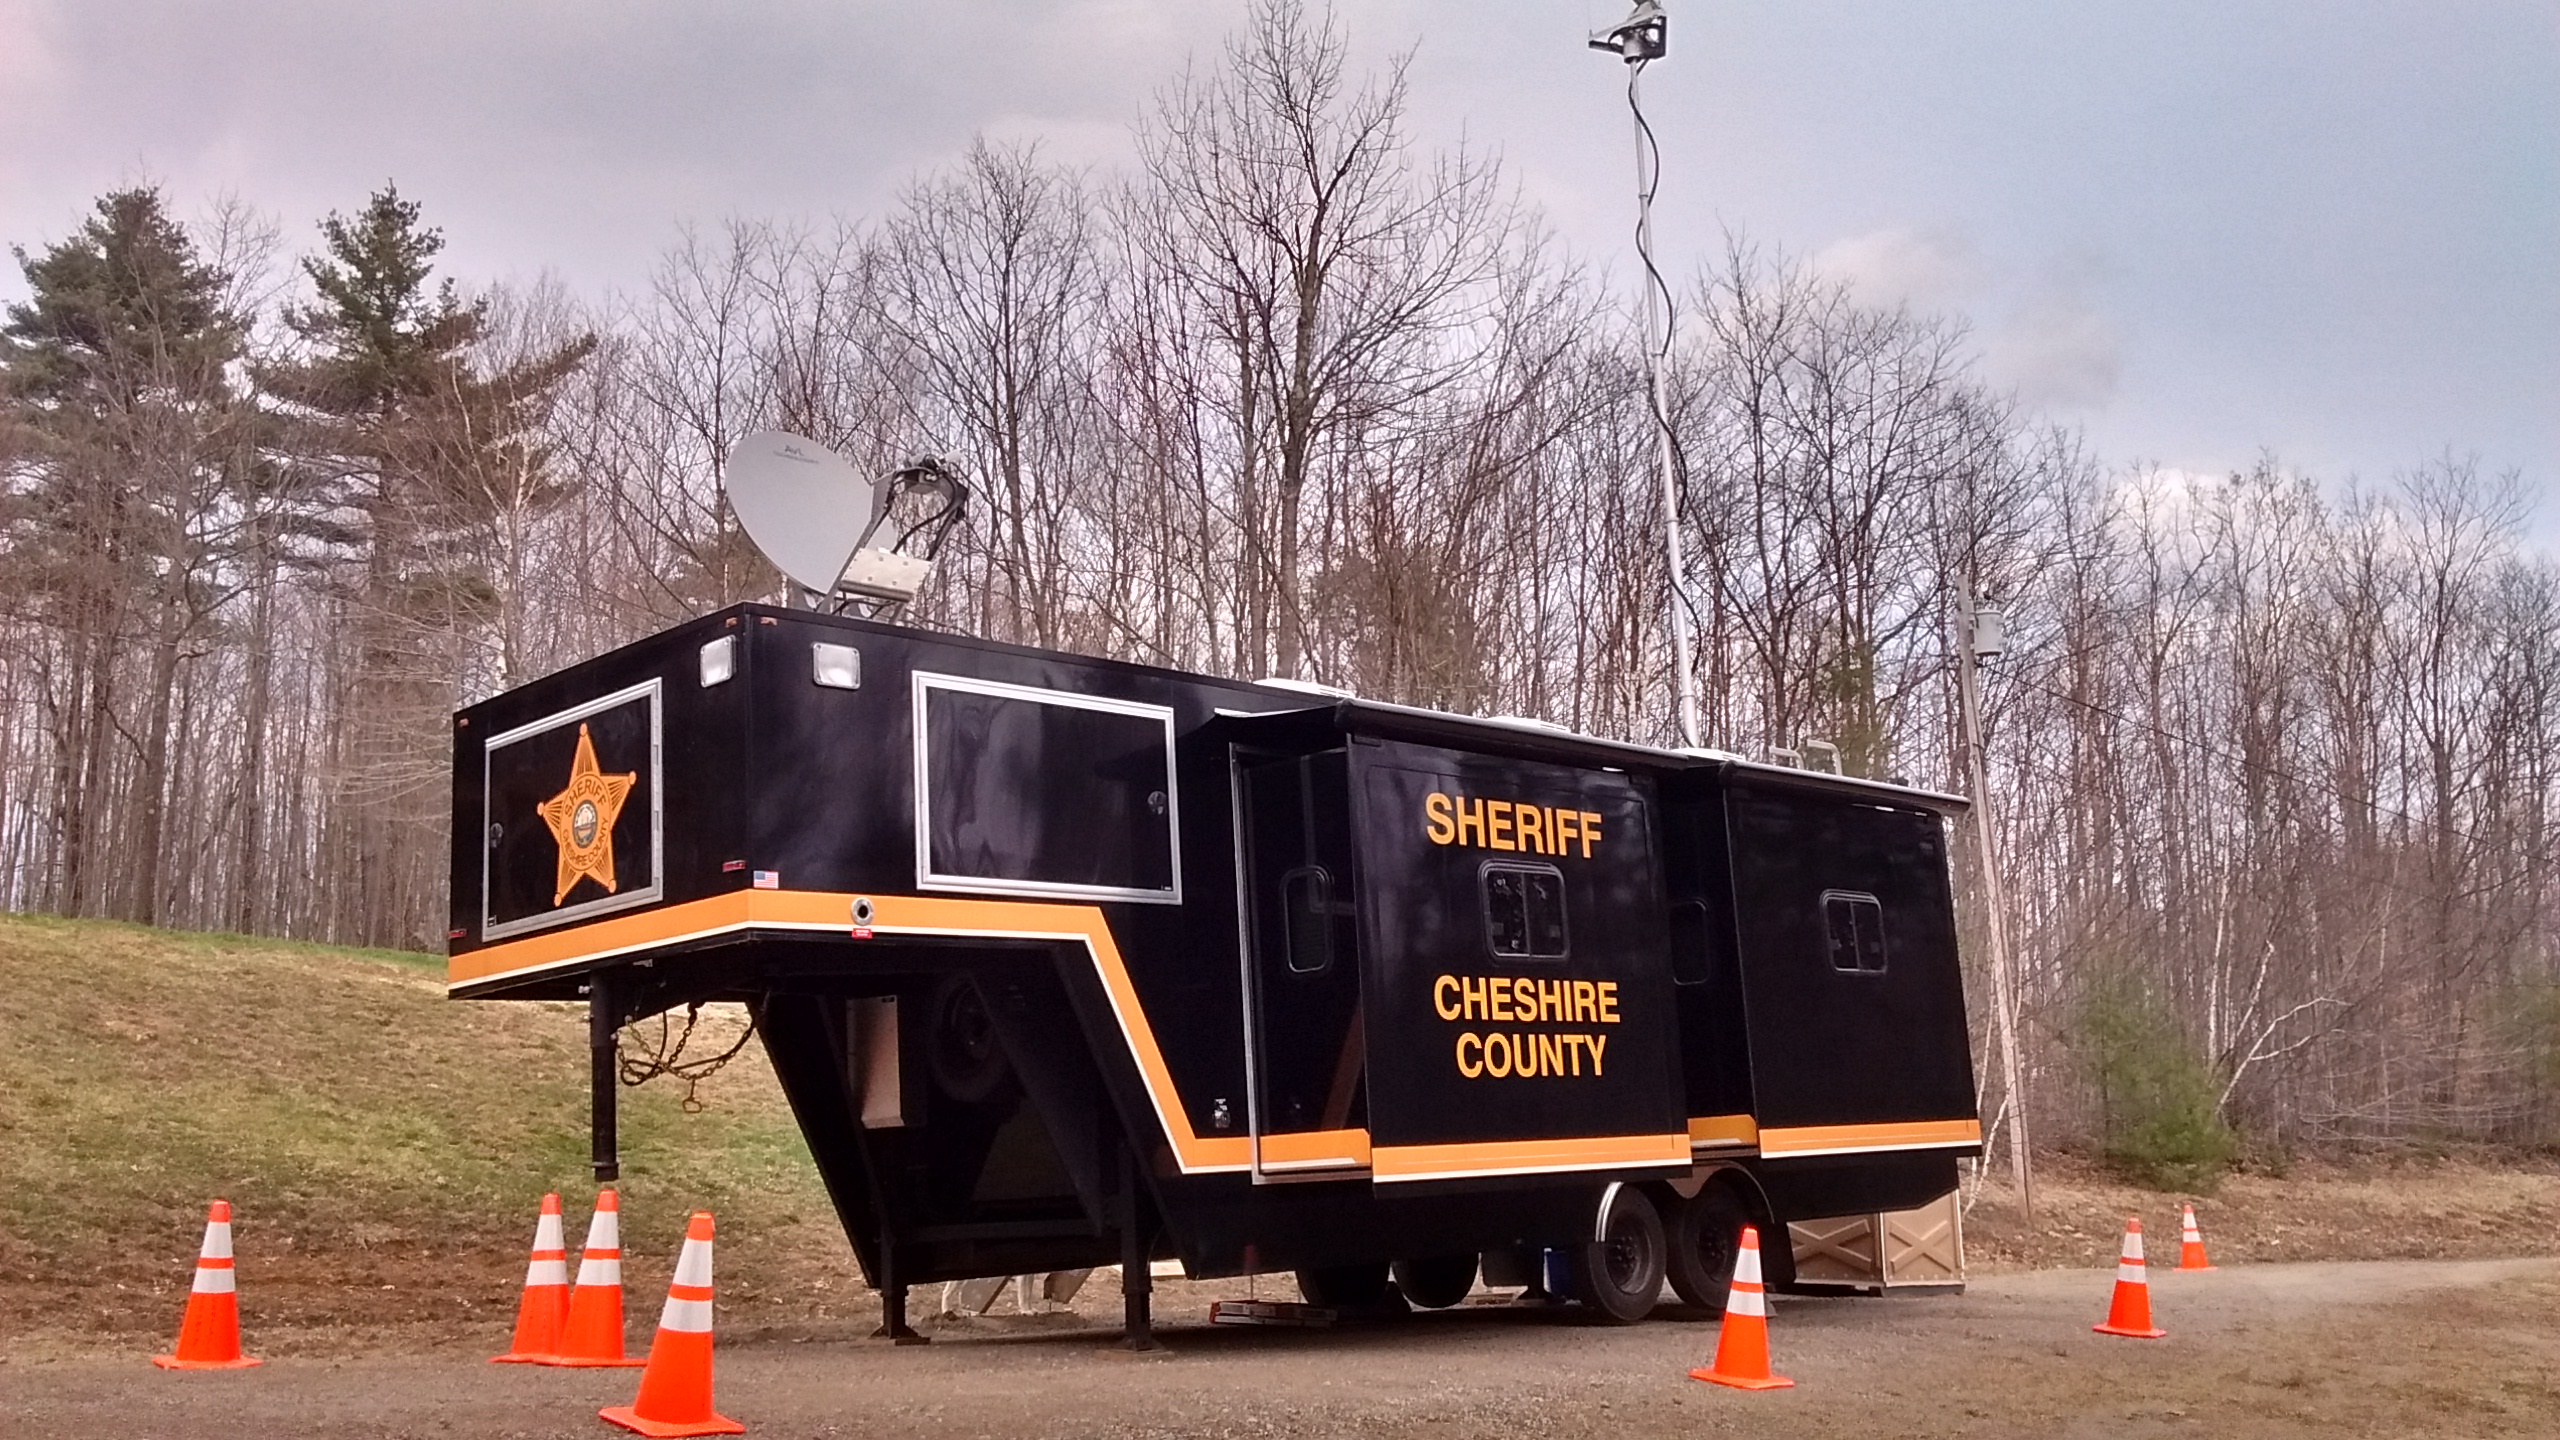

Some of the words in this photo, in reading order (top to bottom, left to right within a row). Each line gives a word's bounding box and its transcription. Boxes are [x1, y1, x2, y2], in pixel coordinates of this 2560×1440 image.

[565, 779, 606, 817] SHERIFF
[588, 817, 608, 862] COUNTY
[1425, 792, 1602, 859] SHERIFF
[1434, 974, 1621, 1023] CHESHIRE
[1456, 1032, 1607, 1078] COUNTY
